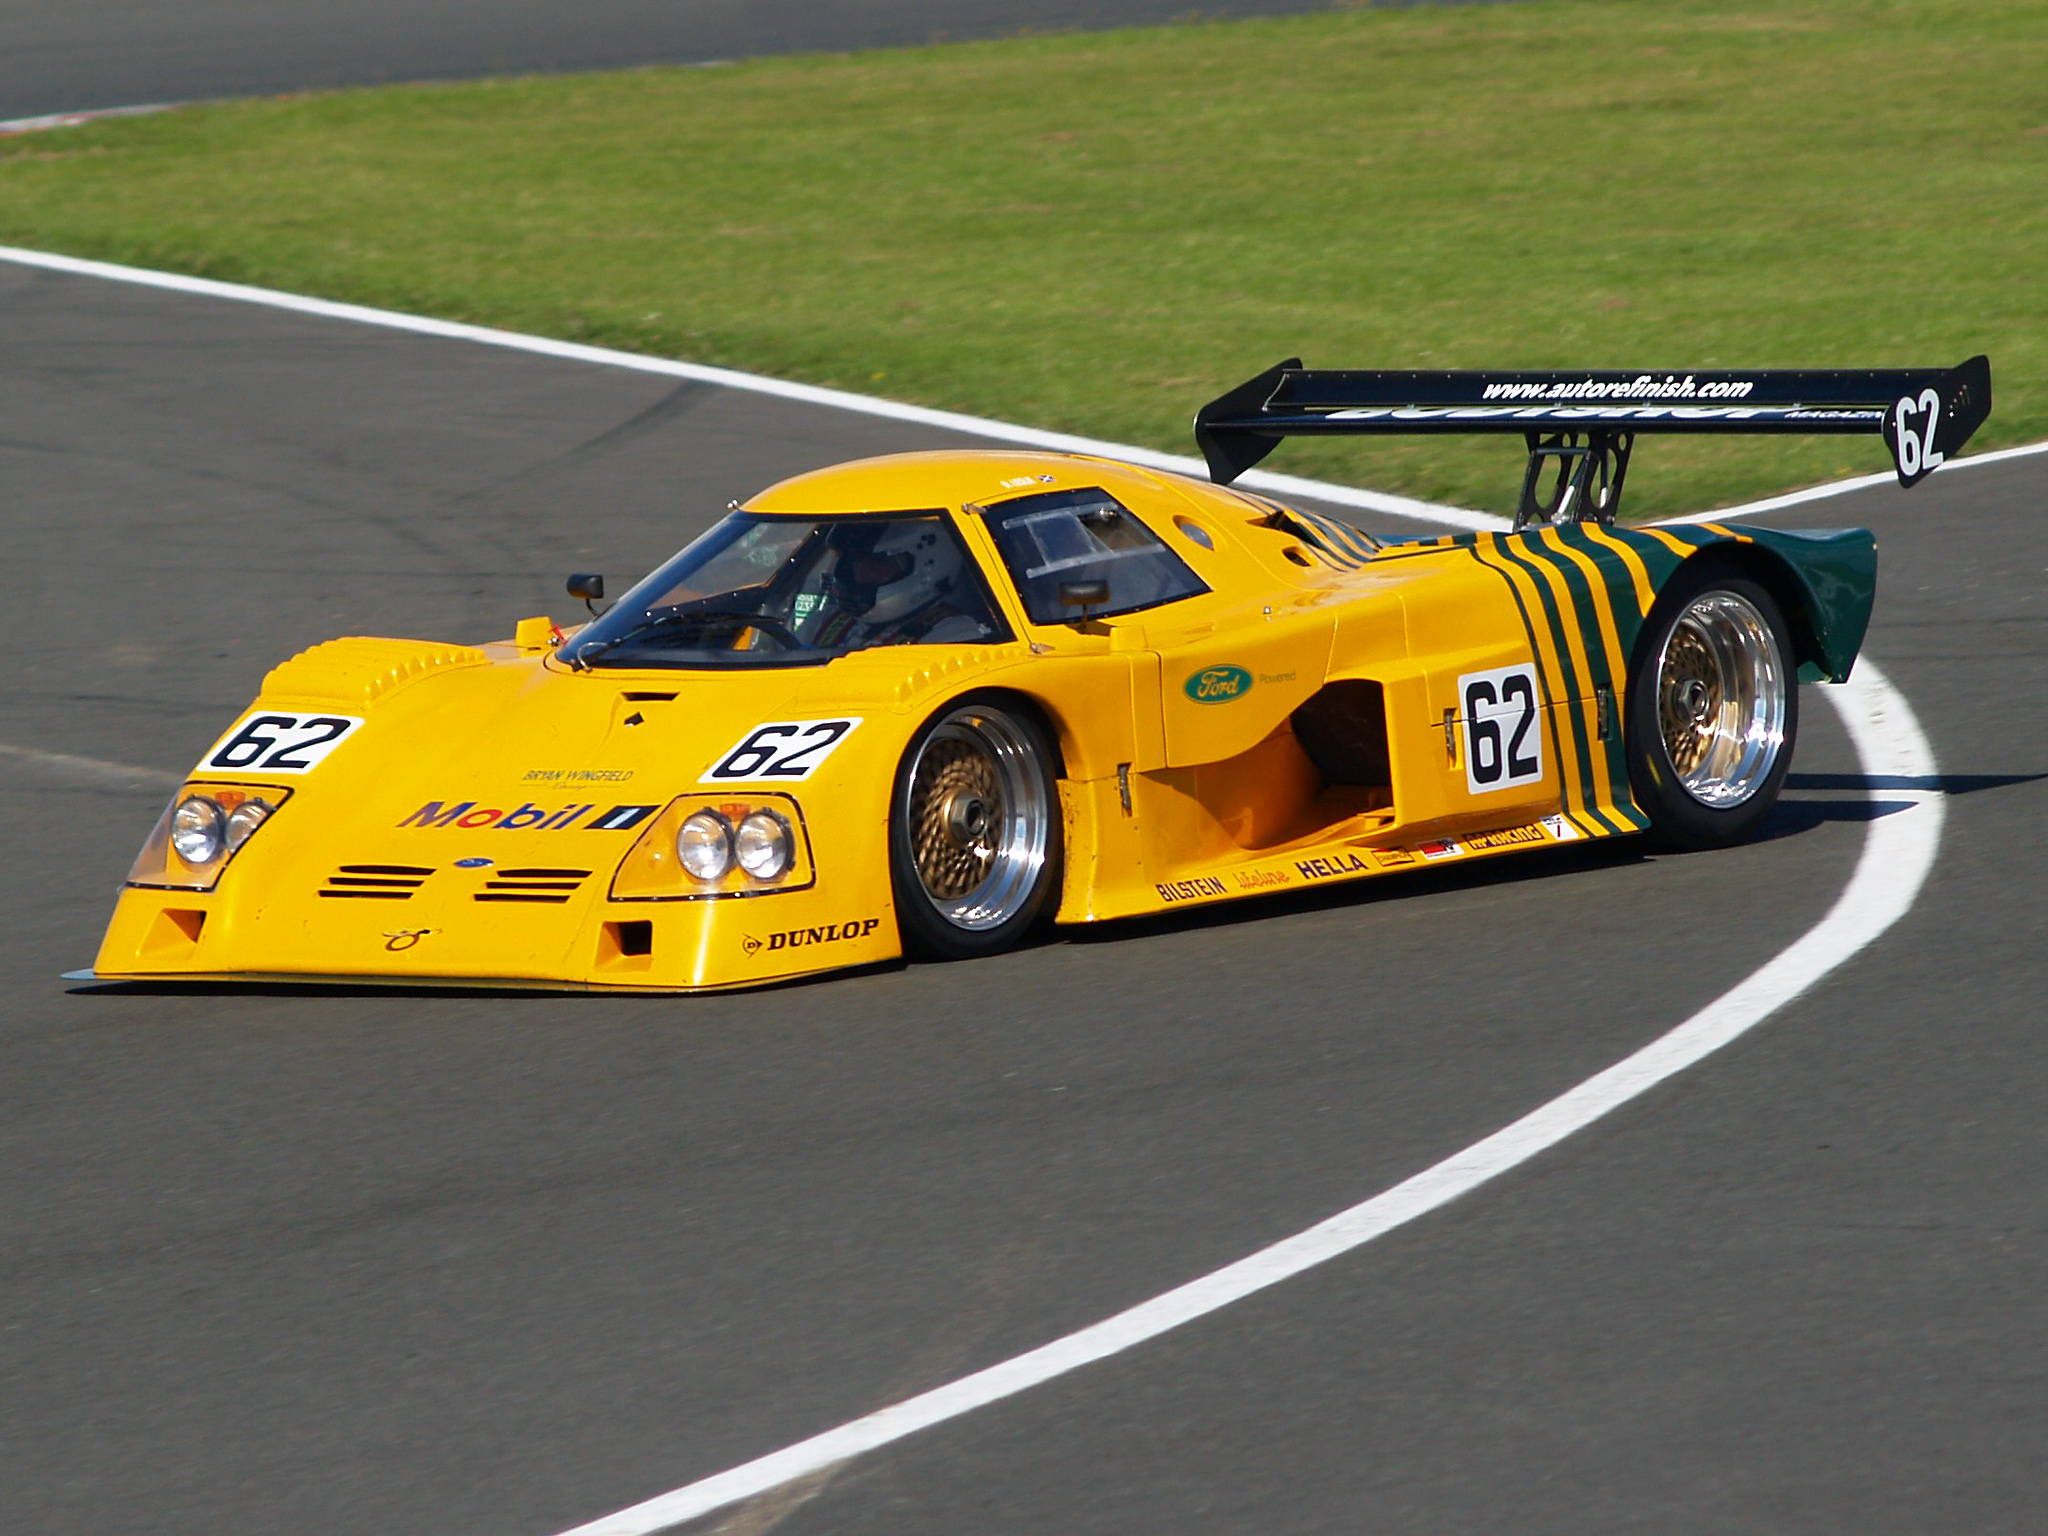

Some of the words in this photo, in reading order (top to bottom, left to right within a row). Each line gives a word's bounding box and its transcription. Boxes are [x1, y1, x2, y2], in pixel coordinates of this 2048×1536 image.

[1482, 375, 1753, 399] www.autorefinish.com
[1895, 388, 1944, 477] 62
[1197, 671, 1240, 697] Ford
[1258, 671, 1297, 684] Powered
[210, 715, 352, 770] 62
[1465, 673, 1539, 785] 62
[711, 721, 851, 778] 62
[522, 770, 564, 781] BRYAN
[566, 770, 634, 782] WINGFIELD
[396, 801, 595, 830] Mobil
[1294, 854, 1369, 880] HELLA
[1155, 876, 1229, 902] BILSTEIN
[767, 918, 879, 951] DUNLOP
